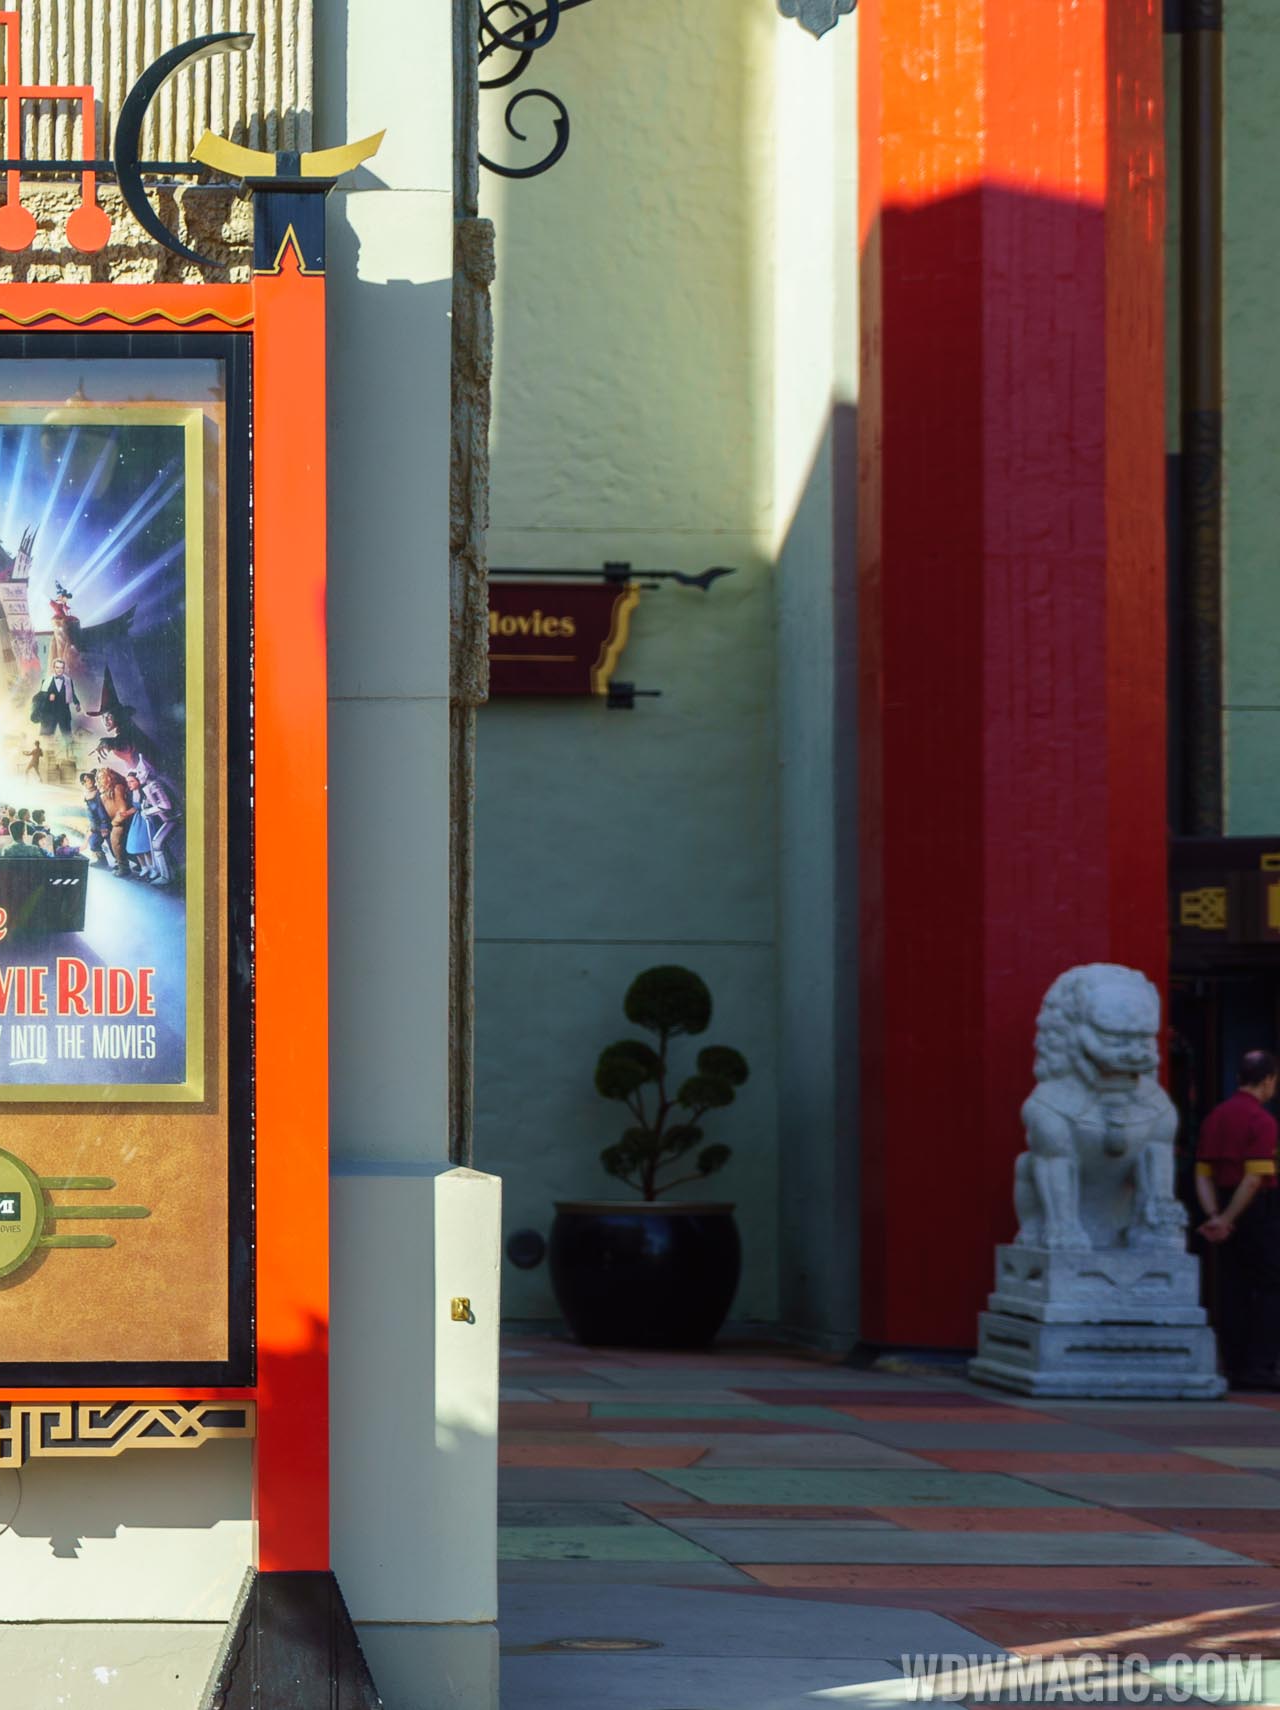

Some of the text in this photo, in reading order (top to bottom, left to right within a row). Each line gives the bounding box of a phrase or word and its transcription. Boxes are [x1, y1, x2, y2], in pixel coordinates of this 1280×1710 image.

[57, 957, 156, 1017] RIDE
[9, 1025, 48, 1066] INTO
[55, 1025, 85, 1060] THE
[93, 1025, 156, 1060] MOVIES
